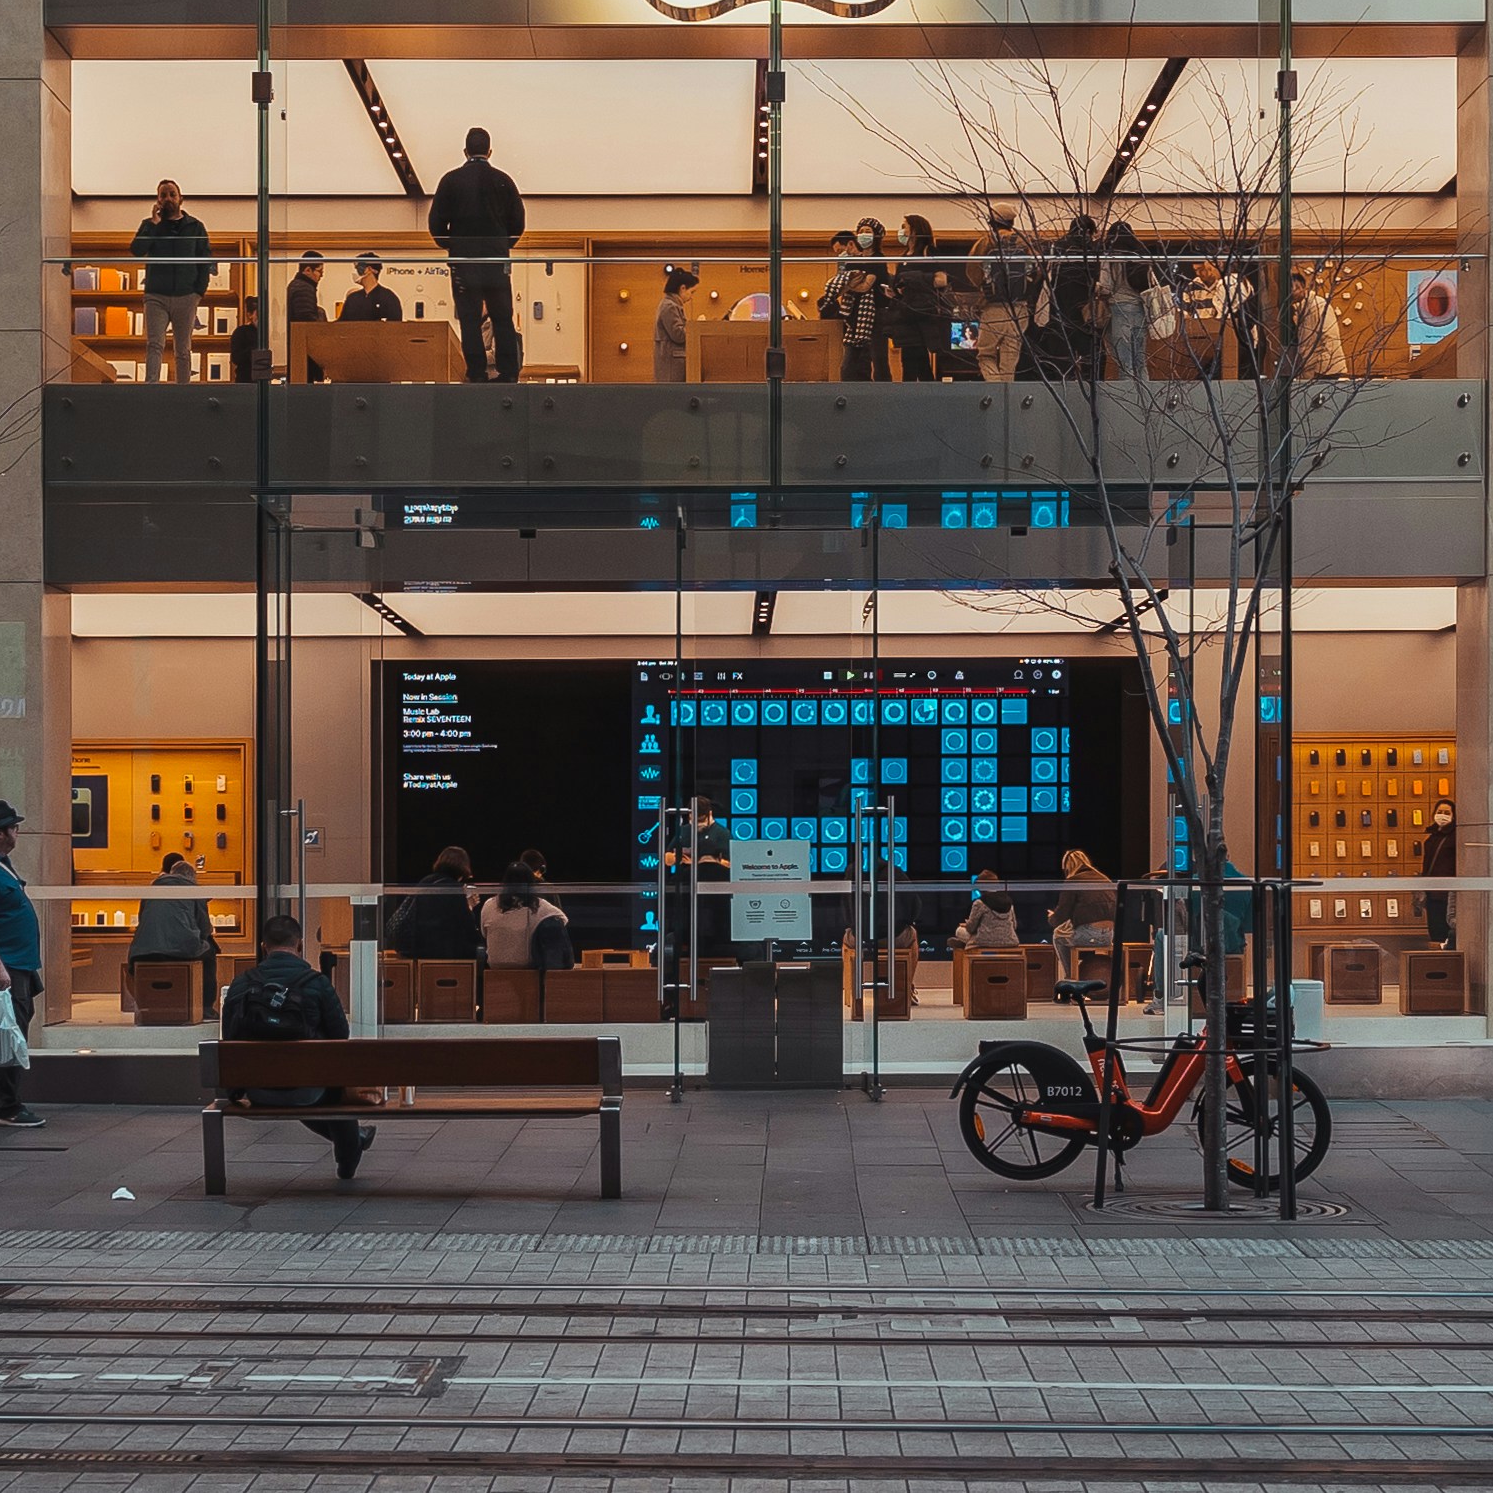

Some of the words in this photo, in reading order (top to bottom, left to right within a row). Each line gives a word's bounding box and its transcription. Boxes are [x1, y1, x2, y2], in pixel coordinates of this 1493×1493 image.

[424, 267, 449, 277] AirTag
[403, 673, 425, 682] Today
[435, 673, 457, 682] Apple
[732, 672, 743, 680] FX
[403, 693, 421, 701] Now
[421, 693, 427, 701] in
[428, 693, 458, 701] Session
[427, 715, 472, 723] SEVENTEEN
[403, 730, 421, 738] 3:00
[440, 730, 458, 738] 4:00
[403, 781, 458, 789] #TodayatApple
[1047, 1087, 1082, 1097] B7012
